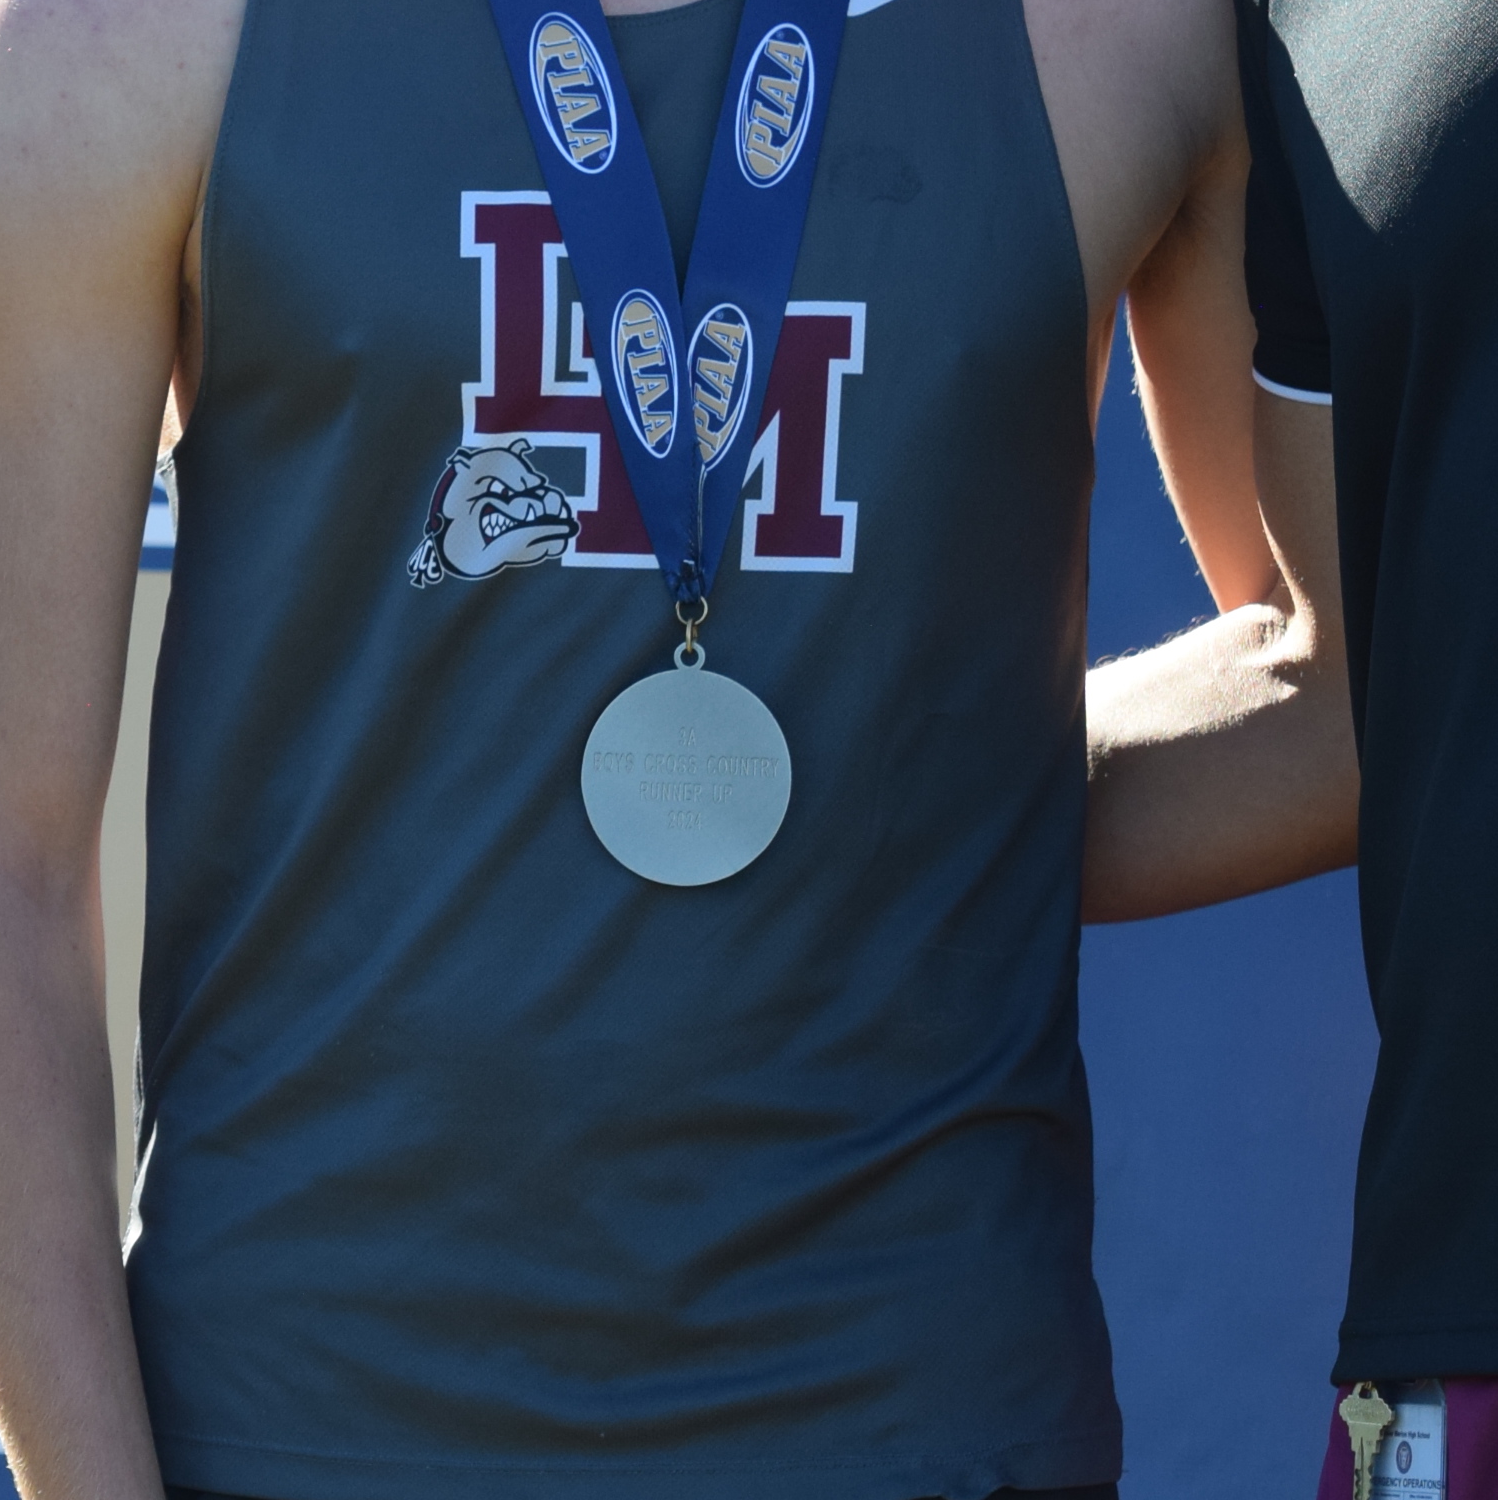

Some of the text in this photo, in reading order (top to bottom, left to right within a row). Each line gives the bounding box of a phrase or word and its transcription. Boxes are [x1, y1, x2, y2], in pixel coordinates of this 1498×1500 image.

[538, 36, 612, 164] PIAA
[745, 37, 807, 167] PIAA
[621, 312, 676, 450] PIAA
[696, 318, 747, 454] PIAA
[593, 751, 781, 779] BOYS CROSS COUNTRY
[639, 781, 734, 805] RUNNER UP
[667, 809, 704, 832] 2024
